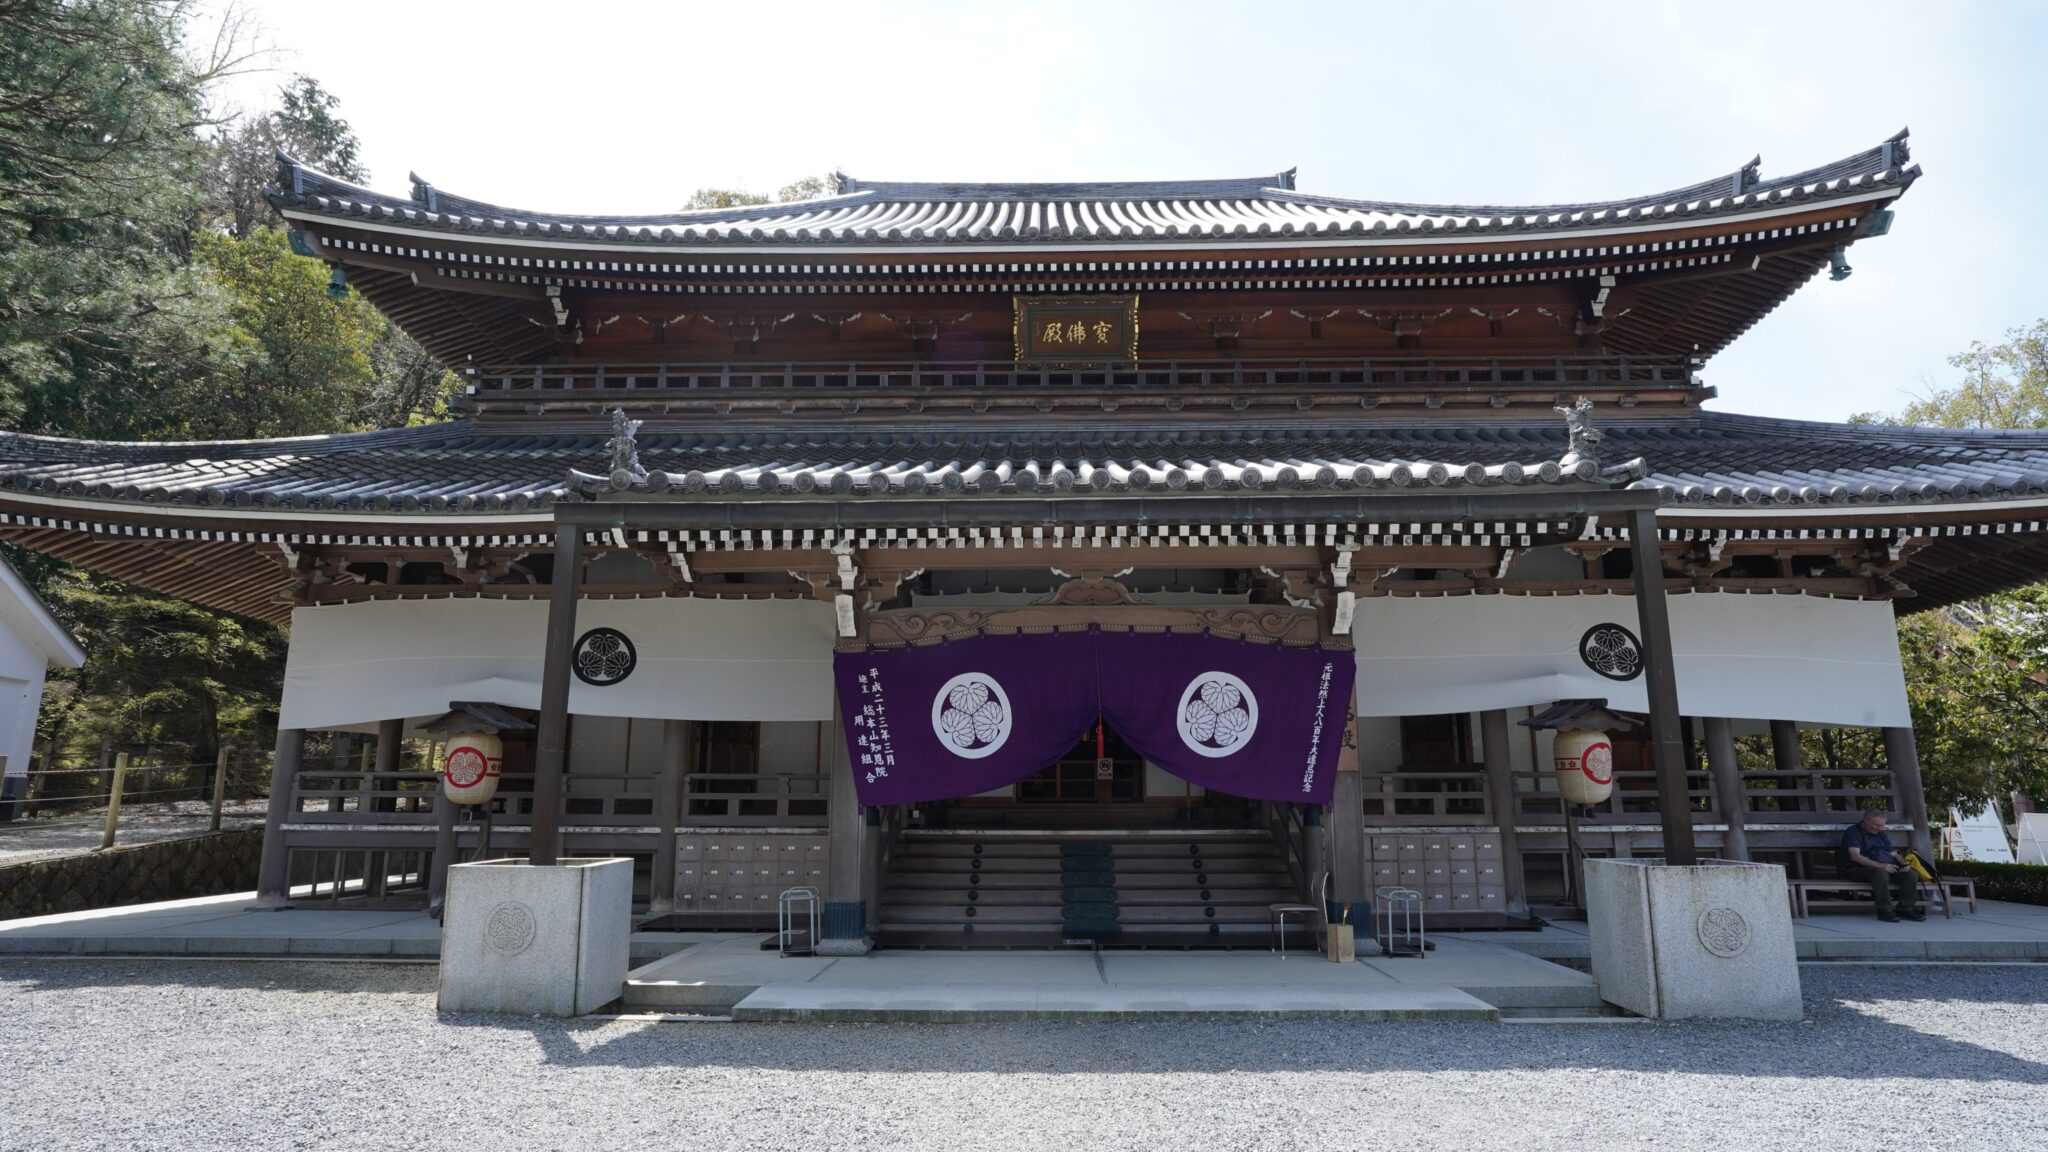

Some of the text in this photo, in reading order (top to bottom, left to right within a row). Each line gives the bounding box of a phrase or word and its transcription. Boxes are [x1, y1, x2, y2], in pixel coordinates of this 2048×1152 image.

[869, 668, 895, 765] 平成二十三年三月
[1302, 663, 1333, 793] 元祖法然上人八百年大遠忌記念
